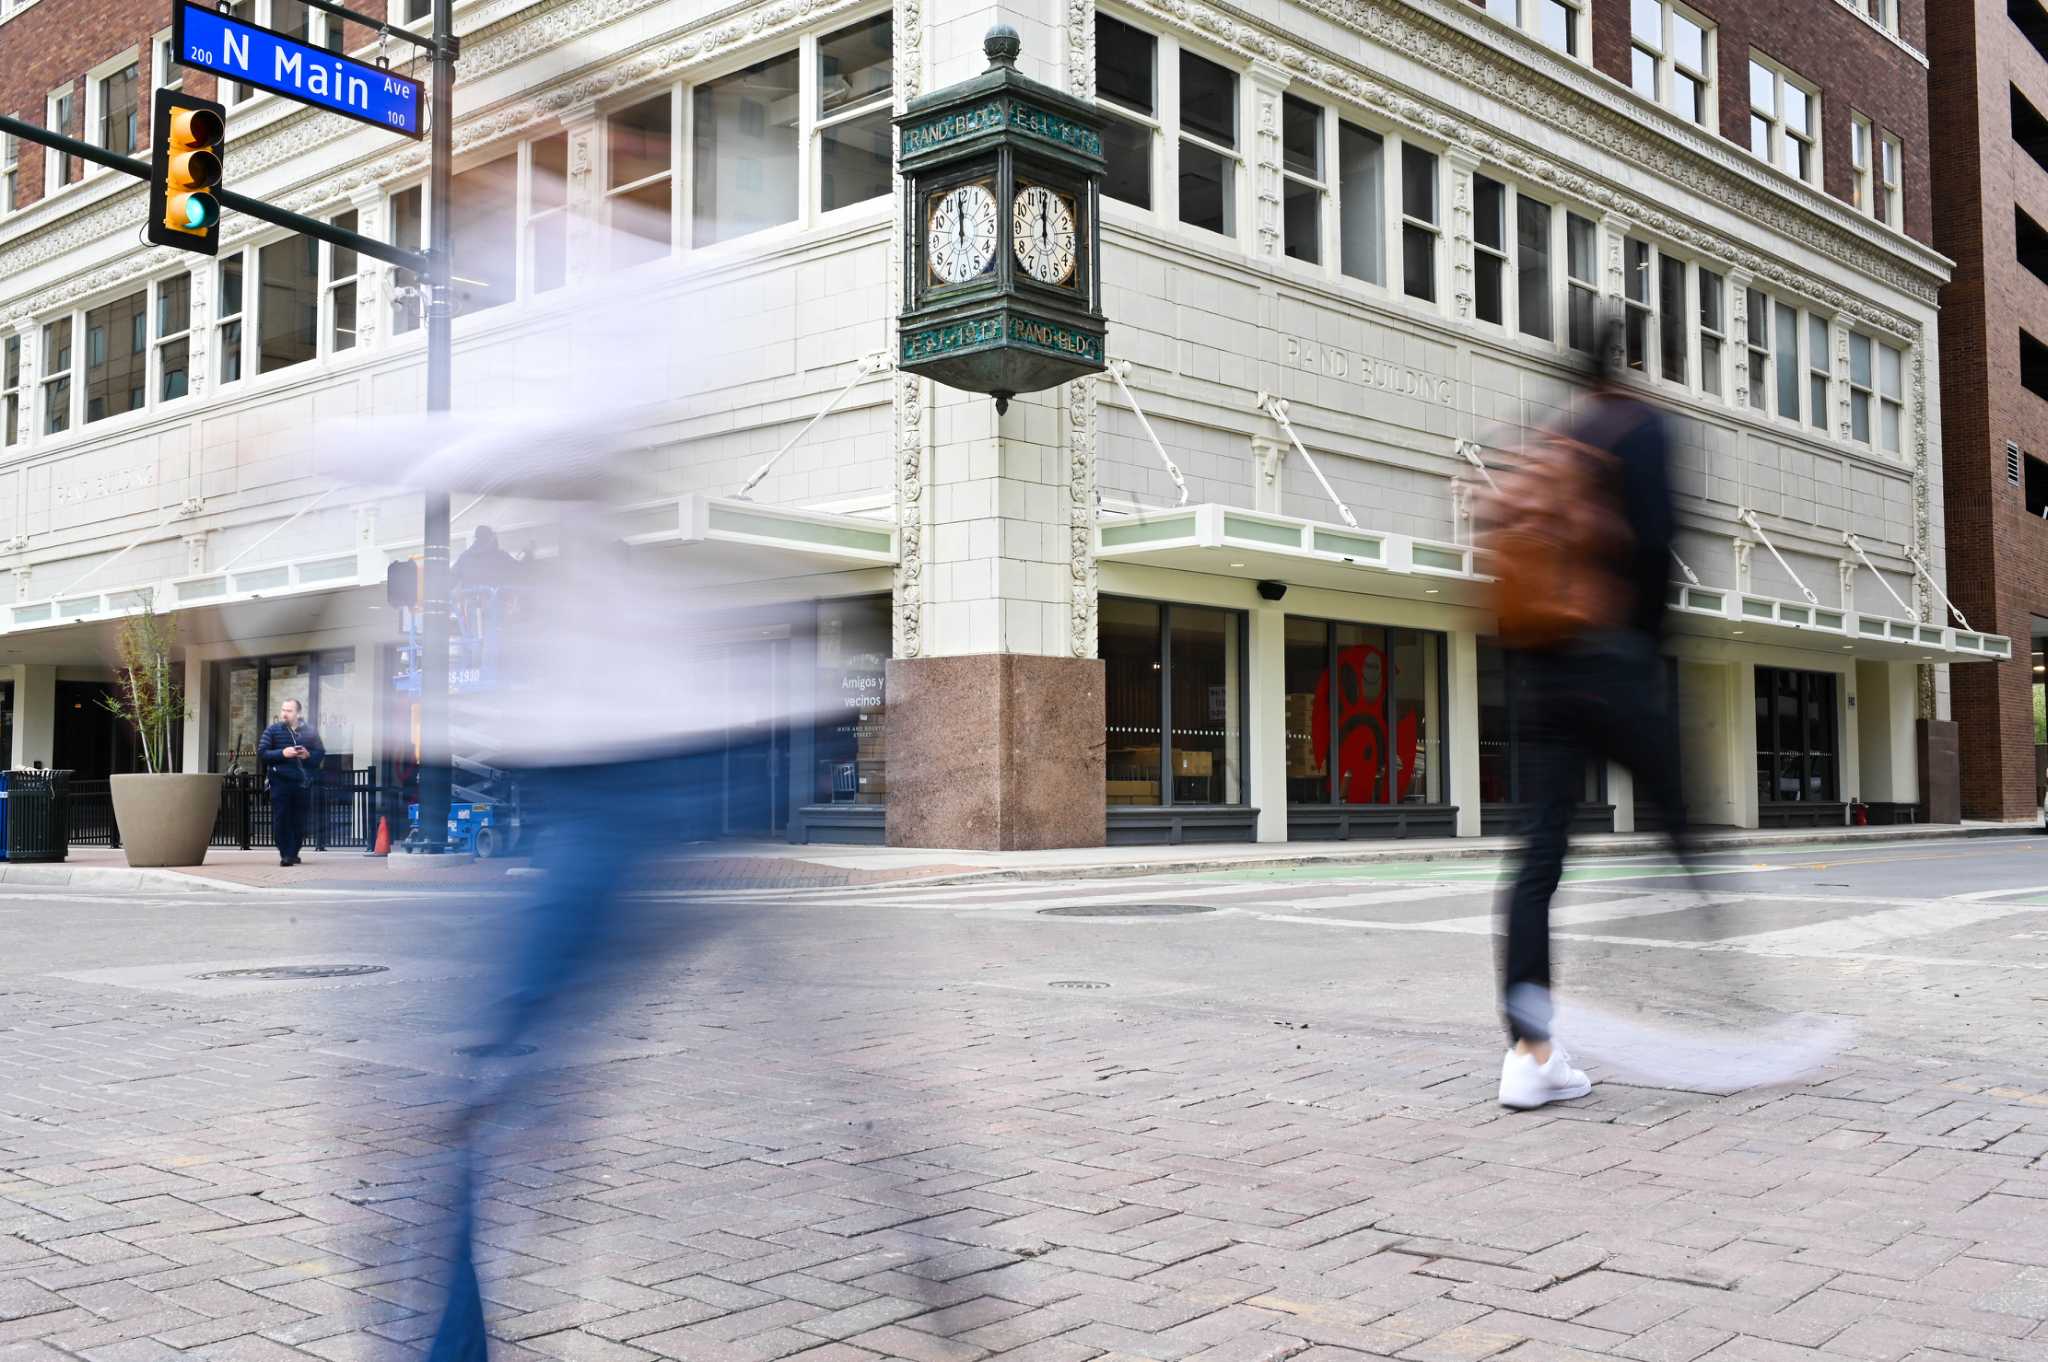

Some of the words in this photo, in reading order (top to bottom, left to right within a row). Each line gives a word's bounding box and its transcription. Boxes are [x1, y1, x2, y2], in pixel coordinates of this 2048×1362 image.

[191, 46, 213, 65] 200
[223, 28, 249, 71] N
[274, 45, 369, 110] Main
[384, 77, 410, 99] Ave
[387, 110, 405, 127] 100
[946, 199, 953, 214] 11
[1028, 191, 1035, 207] 11
[983, 202, 990, 218] 2
[1017, 202, 1027, 217] 10
[935, 215, 945, 230] 10
[987, 219, 995, 235] 3
[1015, 220, 1022, 235] 9
[1061, 216, 1068, 231] 2
[932, 235, 940, 249] 9
[982, 239, 991, 254] 4
[1018, 240, 1025, 254] 8
[1065, 235, 1072, 250] 3
[936, 252, 943, 266] 8
[973, 255, 980, 270] 5
[1028, 255, 1034, 270] 7
[1061, 253, 1068, 267] 4
[946, 262, 953, 277] 7
[960, 263, 967, 278] 6
[1040, 264, 1047, 279] 6
[1053, 263, 1060, 277] 5
[1287, 338, 1348, 377] RAND
[1361, 357, 1451, 403] BUILDING
[841, 676, 877, 691] Amigos
[877, 677, 885, 690] y
[844, 694, 881, 707] vecinos
